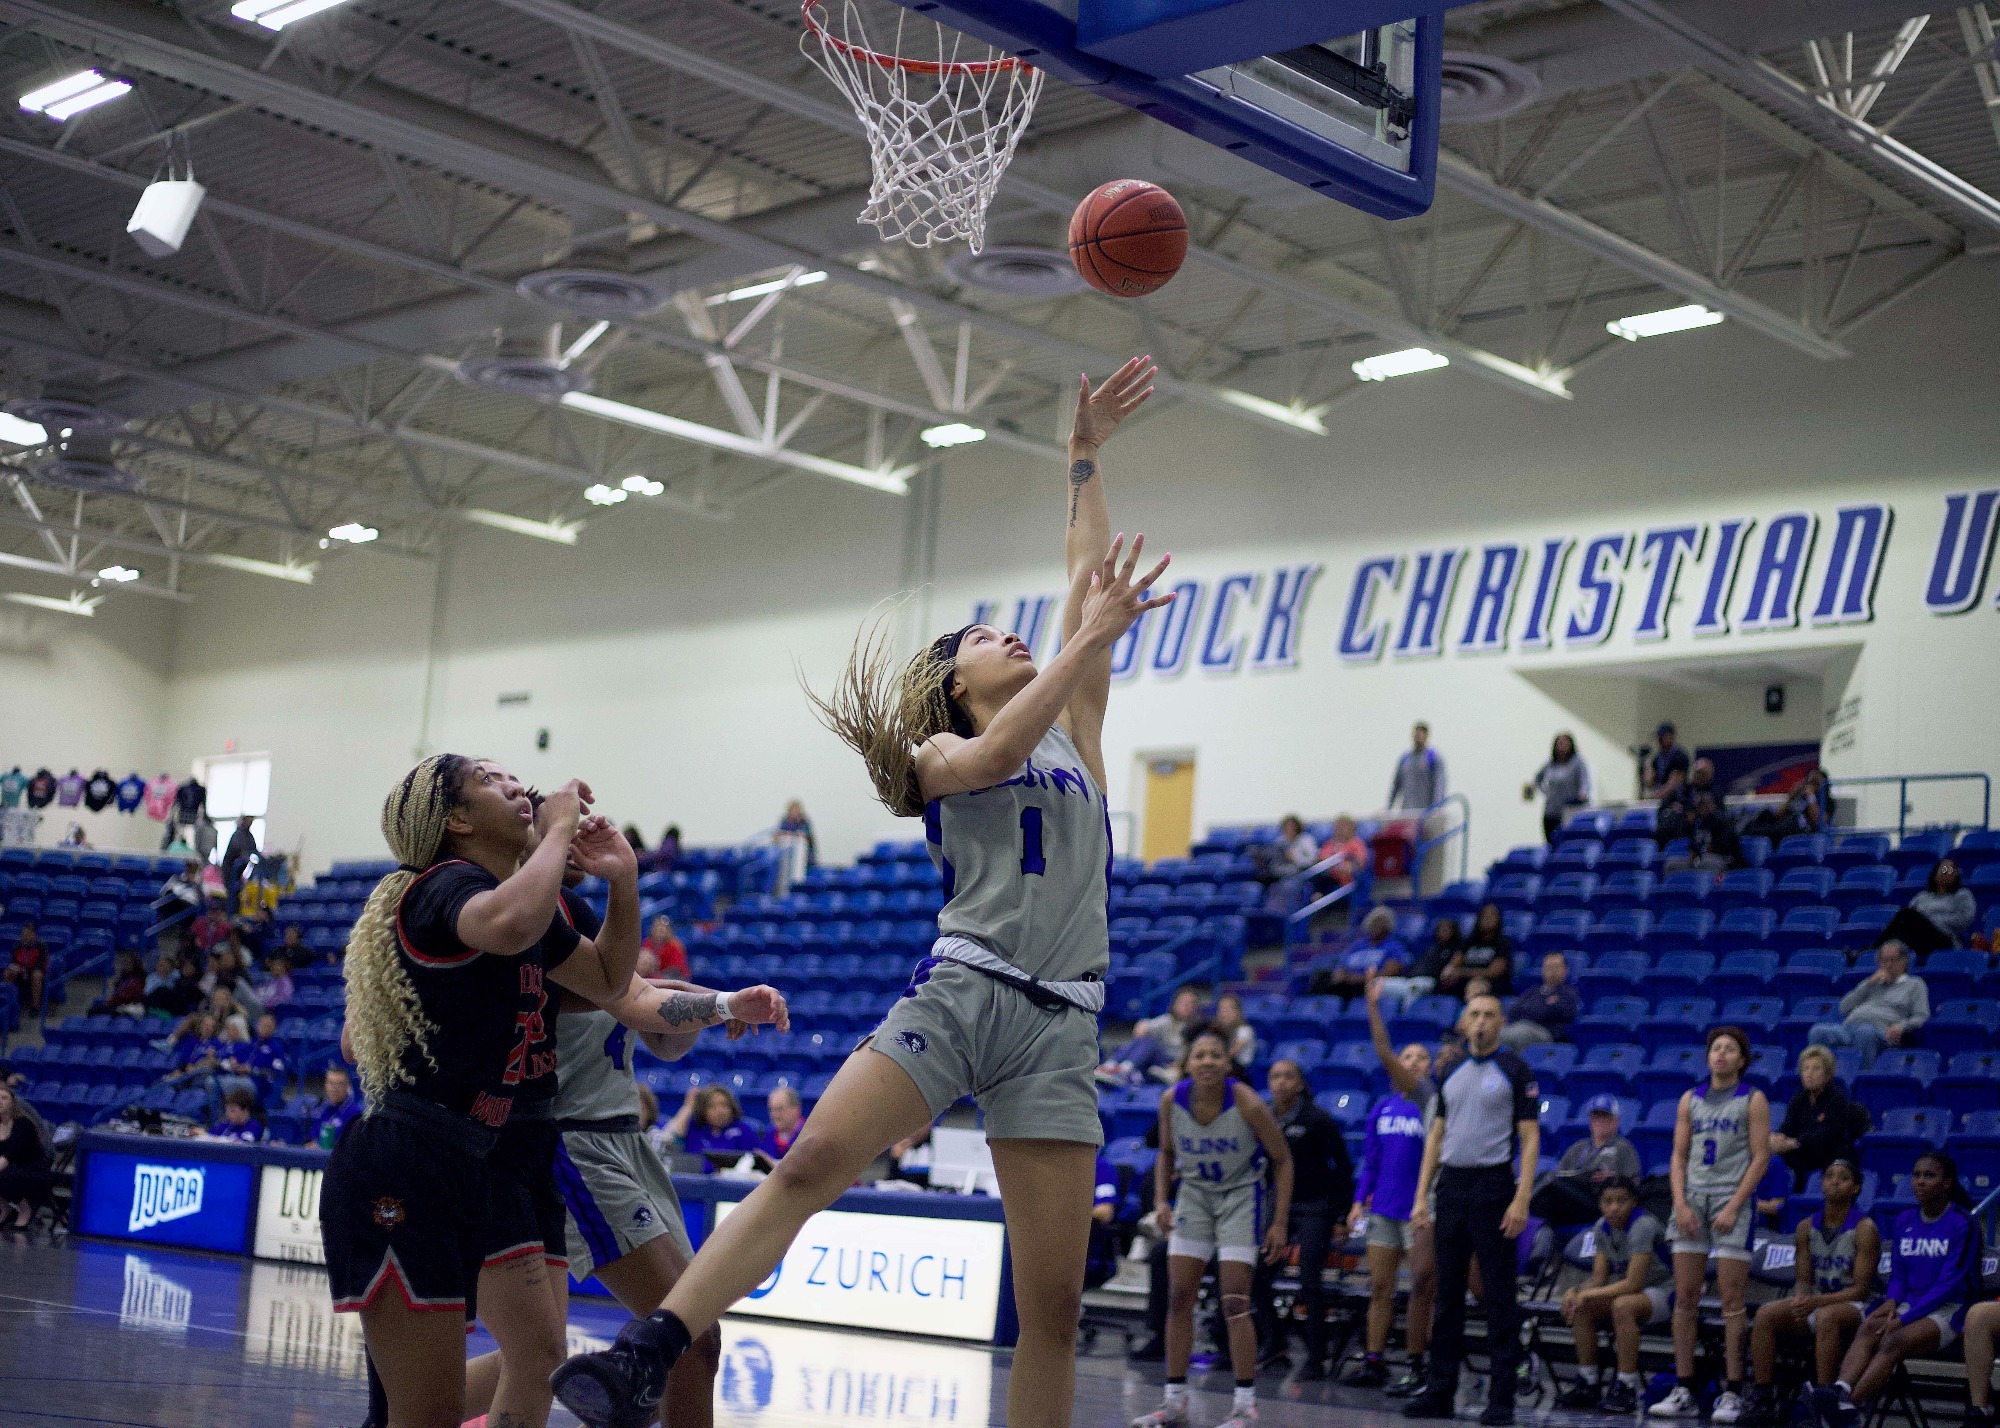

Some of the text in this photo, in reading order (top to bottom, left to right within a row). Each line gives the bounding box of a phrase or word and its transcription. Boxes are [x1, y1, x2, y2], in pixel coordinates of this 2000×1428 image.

[973, 488, 2000, 681] UBOCK CHRISTIAN U
[1020, 806, 1046, 877] 1
[1703, 1139, 1716, 1165] 3
[132, 1168, 201, 1226] NJCAA
[806, 1246, 968, 1300] ZURICH
